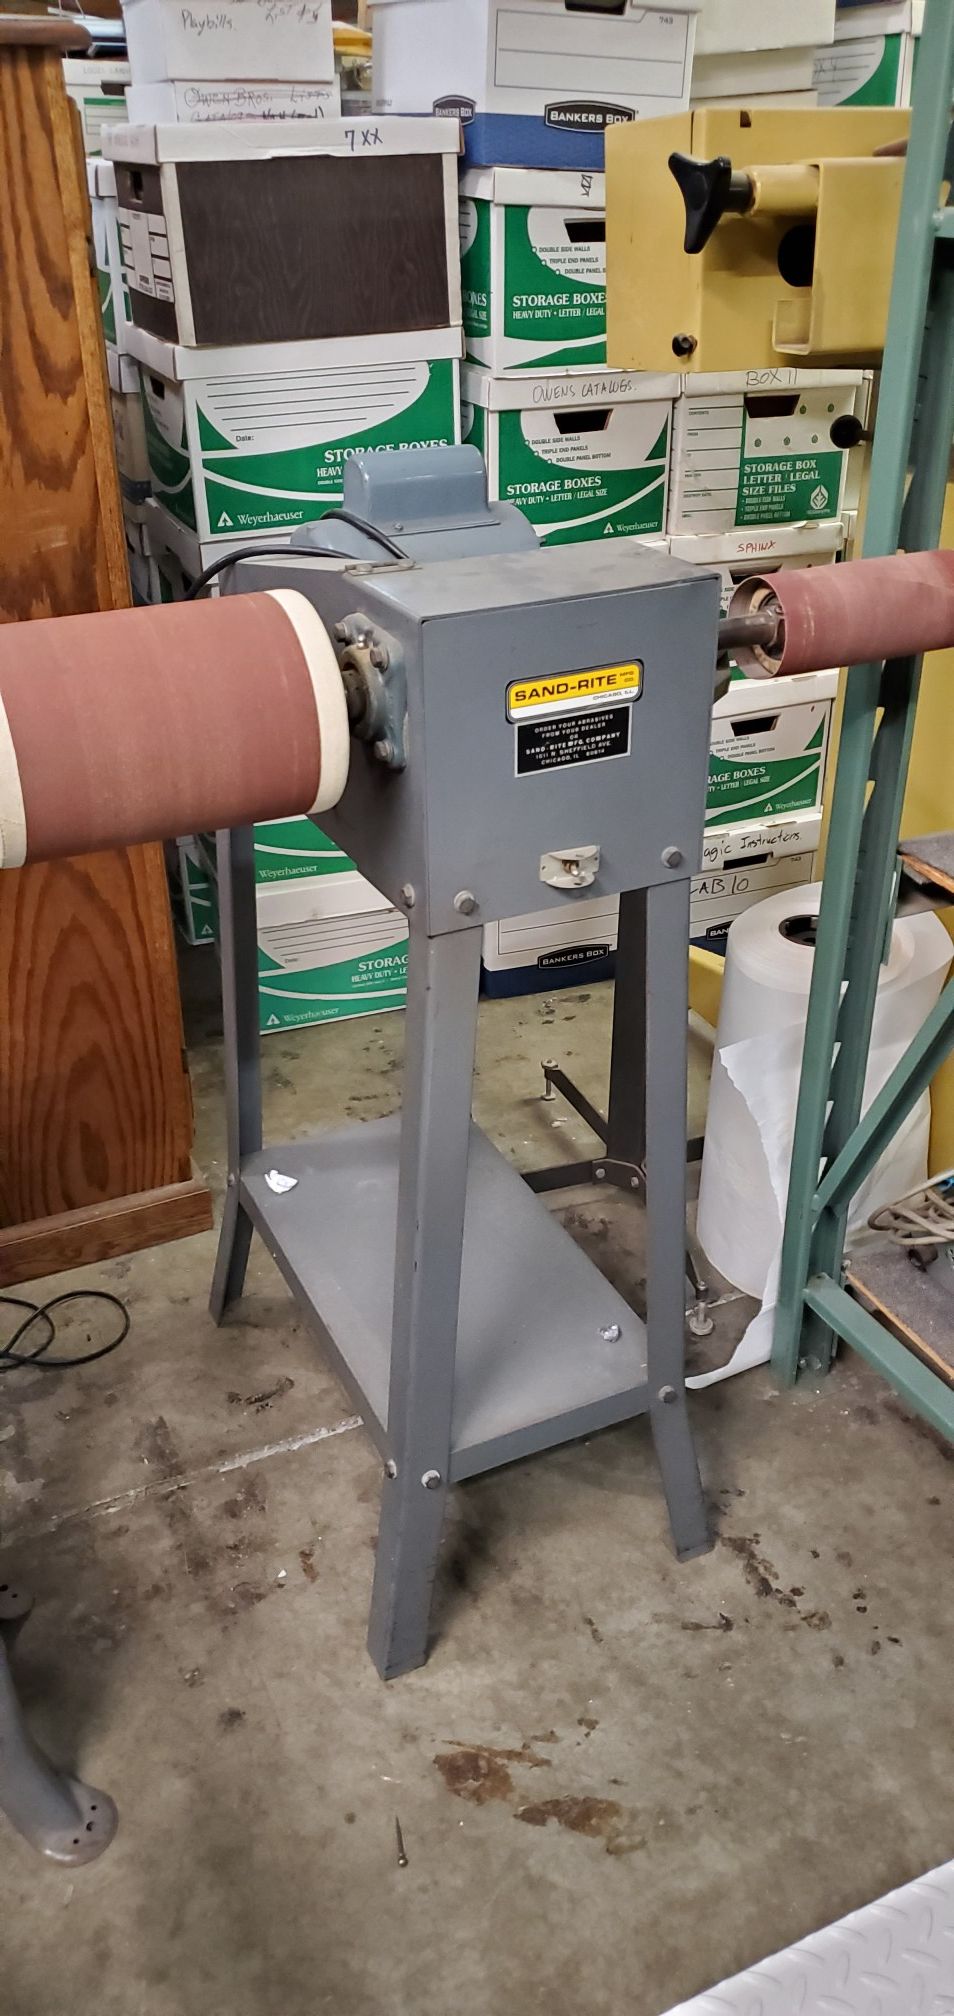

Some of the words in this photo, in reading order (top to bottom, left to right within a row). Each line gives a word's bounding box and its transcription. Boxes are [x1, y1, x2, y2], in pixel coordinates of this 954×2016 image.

[435, 107, 460, 117] BANKERS
[461, 107, 473, 117] BOX
[550, 110, 603, 123] BANKERS
[606, 113, 629, 124] BOX
[512, 293, 570, 308] STORAGE
[573, 292, 607, 304] BOXE
[512, 310, 533, 319] HEAVY
[535, 309, 552, 318] DUTY
[558, 308, 581, 317] LETTER
[586, 307, 605, 316] LEGAL
[746, 367, 782, 386] BOX
[532, 384, 576, 404] OWENS
[236, 434, 254, 442] Date:
[316, 466, 343, 478] HEAVY
[744, 461, 793, 474] STORAGE
[796, 459, 817, 469] BOX
[743, 473, 782, 485] LETTER
[790, 470, 820, 482] LEGAL
[506, 480, 561, 496] STORAGE
[564, 476, 602, 490] BOXES
[742, 485, 766, 496] SIZE
[768, 483, 797, 494] FILES
[528, 495, 544, 504] DUTY
[551, 493, 572, 502] LETTER
[577, 490, 594, 499] LEGAL
[595, 488, 608, 496] SIZE
[237, 509, 304, 525] Weyerhaeuser
[616, 521, 658, 533] Weyerhaeuser
[736, 540, 776, 553] SPHINX
[515, 674, 617, 702] SAND-RITE
[535, 725, 556, 733] ORDER
[558, 721, 576, 729] YOUR
[577, 714, 614, 725] ABRASIVES
[541, 730, 560, 738] FROM
[562, 727, 579, 735] YOUR
[581, 722, 606, 732] DEALER
[586, 732, 620, 743] COMPANY
[559, 743, 597, 755] SHEFFIELD
[733, 767, 766, 779] BOXES
[721, 782, 740, 791] LETTER
[259, 864, 318, 879] Weyerhaeuser
[542, 952, 585, 966] BANKERS
[586, 948, 605, 958] BOX
[351, 973, 374, 983] HEAVY
[374, 969, 391, 979] DUTY
[283, 1007, 340, 1023] Weyerhaeuser
